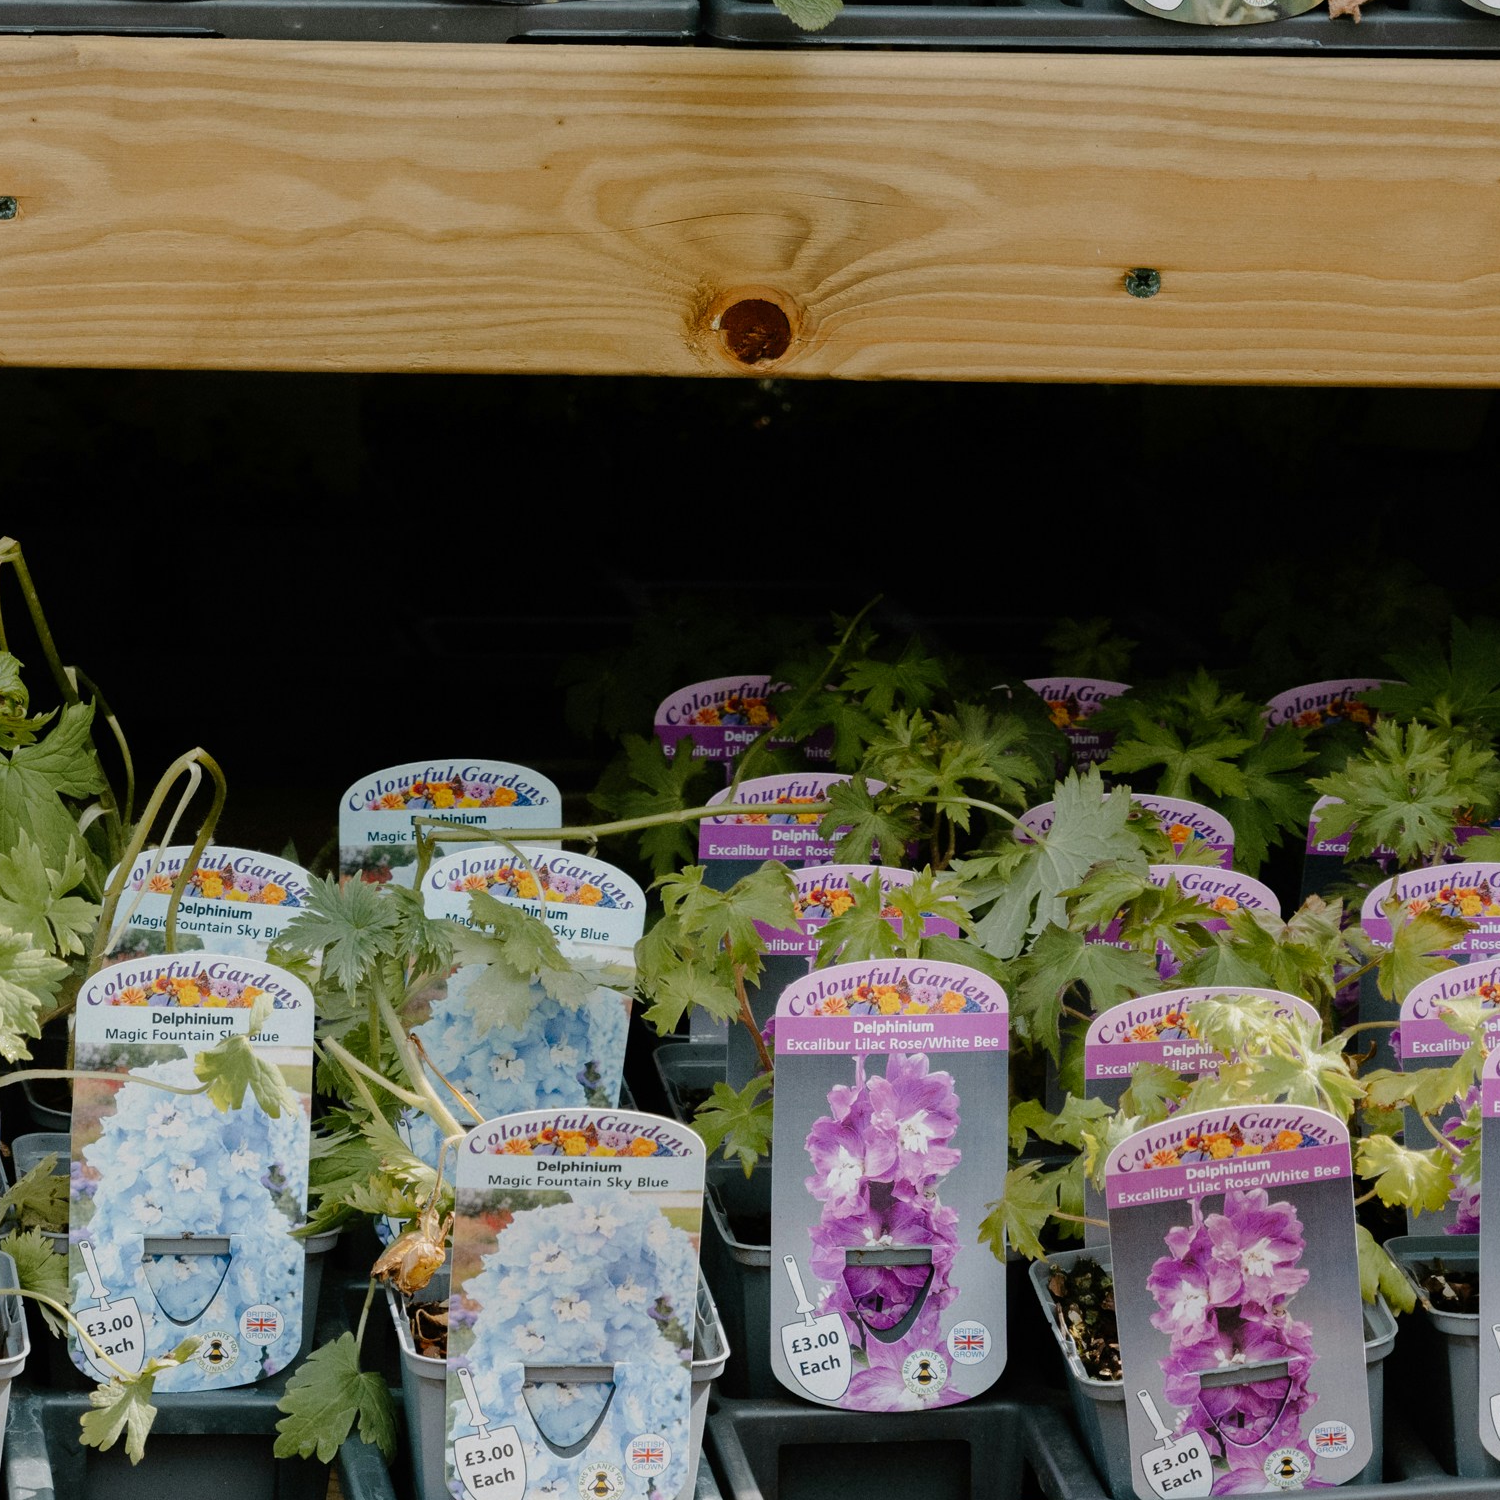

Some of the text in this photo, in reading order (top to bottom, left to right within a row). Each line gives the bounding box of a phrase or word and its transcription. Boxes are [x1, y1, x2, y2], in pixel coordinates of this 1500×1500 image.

[788, 966, 999, 1016] Colourful Gardens
[853, 1021, 935, 1036] Delphinium
[786, 1035, 999, 1051] Excalibur Lilac Rose/White Bee
[468, 1114, 693, 1157] Colourful Gardens
[536, 1161, 622, 1174] Delphinium
[487, 1174, 670, 1190] Magic Fountain Sky Blue
[791, 1331, 840, 1354] £3.00
[799, 1354, 841, 1376] Each
